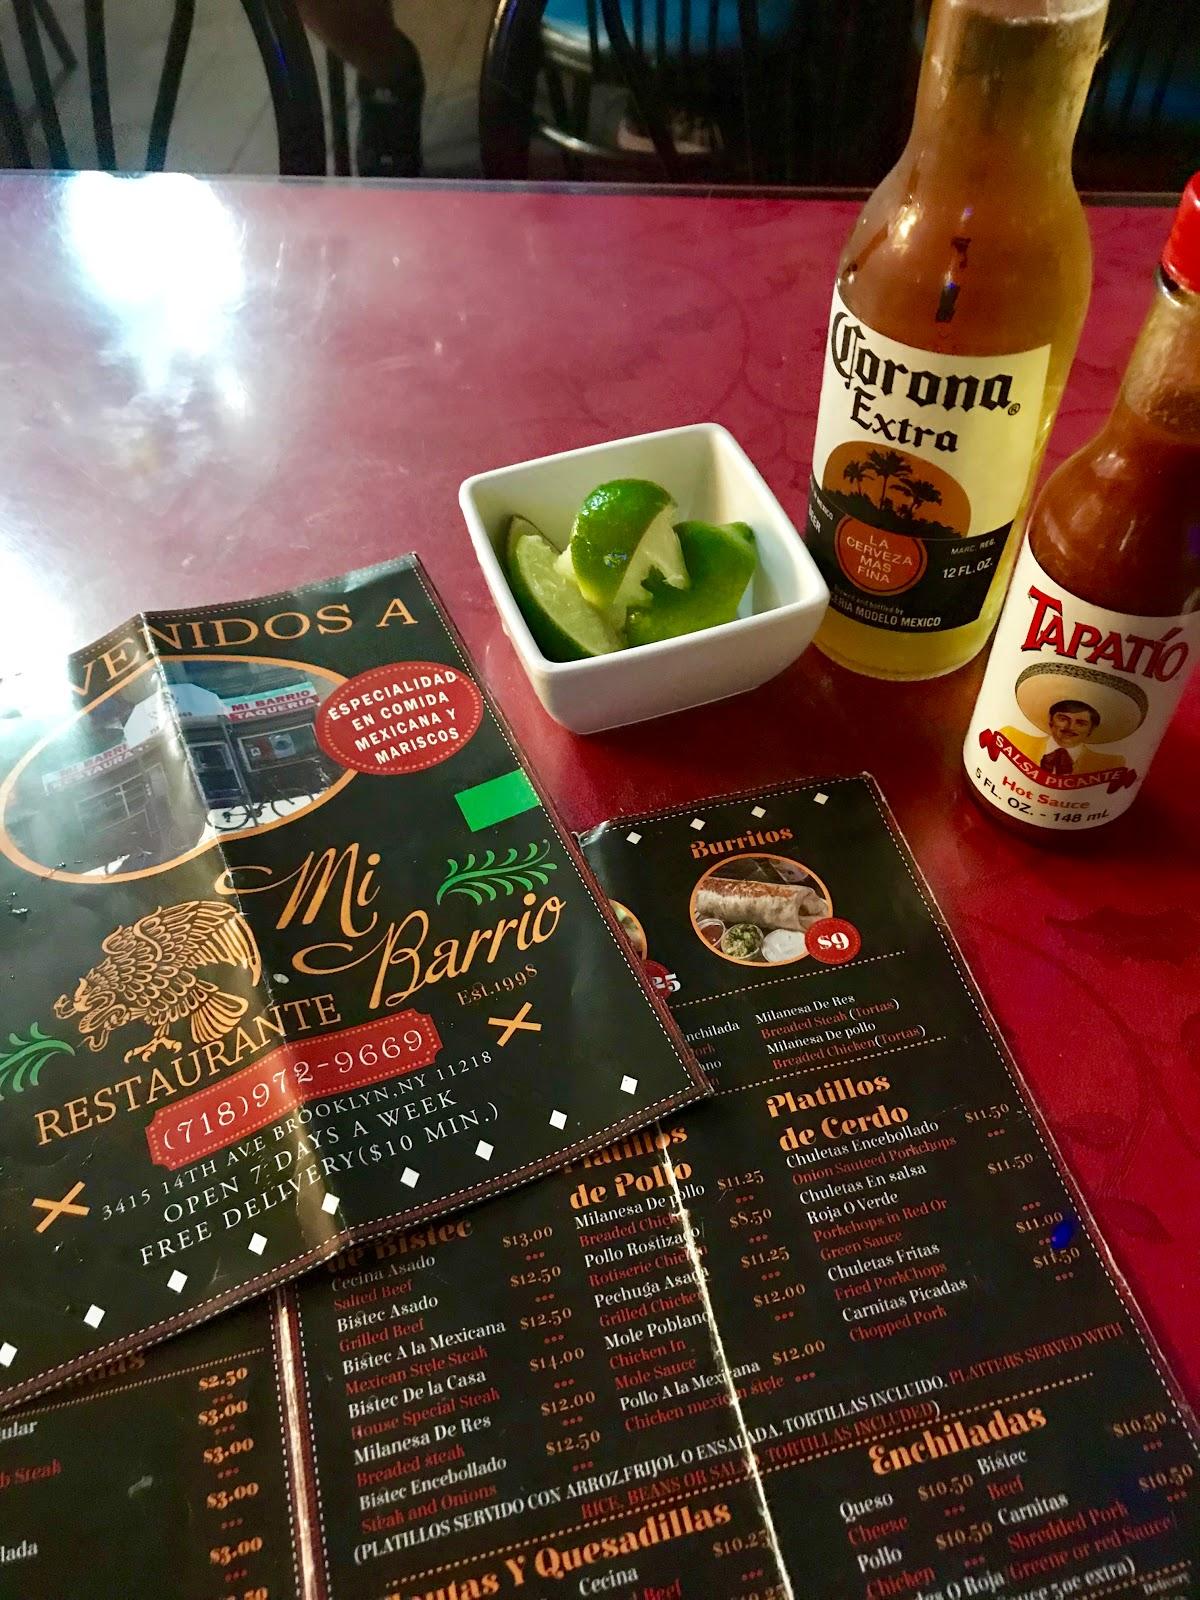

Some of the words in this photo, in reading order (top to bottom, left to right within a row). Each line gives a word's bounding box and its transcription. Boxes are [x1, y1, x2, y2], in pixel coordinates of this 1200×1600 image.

[831, 312, 1014, 411] Corona
[851, 386, 958, 452] Extra
[847, 536, 913, 566] CERVEZA
[870, 535, 889, 548] LA
[858, 567, 890, 584] FINA
[860, 556, 891, 572] MAS
[943, 568, 955, 578] 12
[376, 598, 418, 628] A
[856, 606, 897, 625] MODELO
[900, 617, 941, 627] MEXICO
[232, 702, 250, 712] MI
[255, 690, 310, 707] BARRIO
[328, 670, 457, 721] ESPECIALIDAD
[352, 714, 375, 731] EN
[380, 692, 449, 719] COMIDA
[355, 712, 442, 752] MEXICANA
[446, 708, 456, 720] Y
[375, 728, 459, 765] MARISCOS
[995, 735, 1039, 778] SALSA
[1045, 769, 1122, 788] PICANTE
[975, 767, 982, 779] 5
[983, 778, 1002, 800] FL.
[1007, 797, 1034, 816] OZ.
[1053, 812, 1081, 823] 148
[1087, 809, 1109, 821] mL
[1002, 776, 1032, 800] Hot
[1037, 793, 1090, 810] Sauce
[690, 825, 794, 860] Burritos
[214, 842, 381, 938] Mi
[292, 892, 567, 1010] Barrio
[817, 931, 850, 951] $9
[755, 1005, 812, 1025] Milanesa
[812, 999, 830, 1011] De
[832, 994, 856, 1007] Res
[760, 1018, 813, 1040] Breaded
[814, 1012, 848, 1028] Steak
[766, 1035, 824, 1055] Milanesa
[825, 1028, 844, 1041] De
[845, 1020, 876, 1039] pollo
[35, 994, 342, 1146] RESTAURANTE
[772, 1050, 824, 1071] Breaded
[163, 1029, 424, 1150] (718)972-9669
[766, 1074, 891, 1119] Platillos
[779, 1127, 816, 1152] de
[820, 1105, 909, 1139] Cerdo
[964, 1103, 1010, 1124] $11.50
[102, 1189, 150, 1221] 3415
[162, 1160, 217, 1195] 14TH
[226, 1136, 266, 1166] AVE
[437, 1051, 491, 1081] 11218
[786, 1143, 849, 1170] Chuletas
[852, 1120, 939, 1153] Encebollado
[164, 1176, 240, 1224] OPEN
[274, 1126, 339, 1172] DAYS
[353, 1120, 368, 1137] A
[376, 1090, 457, 1127] WEEK
[792, 1165, 834, 1186] Onion
[888, 1135, 957, 1162] Porkchops
[987, 1153, 1034, 1175] $11.50
[140, 1222, 212, 1266] FREE
[424, 1102, 498, 1143] MIN.)
[717, 1169, 764, 1191] $11.25
[799, 1179, 864, 1205] Chuletas
[866, 1174, 886, 1188] En
[888, 1163, 927, 1182] salsa
[569, 1183, 607, 1210] de
[574, 1202, 644, 1230] Milanesa
[646, 1194, 667, 1212] De
[805, 1205, 842, 1225] Roja
[844, 1200, 856, 1215] O
[856, 1191, 899, 1212] Verde
[729, 1208, 772, 1229] $8.50
[813, 1213, 884, 1244] Porkchops
[902, 1203, 930, 1221] Red
[1016, 1211, 1063, 1233] $11.00
[502, 1226, 553, 1249] $13.00
[819, 1241, 861, 1261] Green
[863, 1230, 904, 1249] Sauce
[332, 1268, 384, 1292] Cecina
[387, 1255, 436, 1278] Asado
[584, 1249, 624, 1268] Pollo
[740, 1246, 790, 1269] $11.25
[827, 1255, 894, 1282] Chuletas
[896, 1243, 940, 1264] Fritas
[510, 1266, 561, 1288] $12.50
[594, 1277, 661, 1309] Pechuga
[834, 1279, 870, 1301] Fried
[753, 1283, 806, 1309] $12.00
[841, 1295, 907, 1323] Carnitas
[909, 1277, 968, 1303] Picadas
[337, 1307, 386, 1333] Bistec
[389, 1294, 439, 1319] Asado
[519, 1307, 573, 1330] $12.50
[849, 1315, 912, 1343] Chopped
[913, 1305, 948, 1326] Pork
[342, 1351, 392, 1375] Bistec
[397, 1341, 408, 1360] A
[411, 1337, 426, 1355] la
[429, 1320, 506, 1351] Mexicana
[604, 1322, 644, 1350] Mole
[530, 1347, 584, 1372] $14.00
[609, 1344, 672, 1371] Chicken
[772, 1340, 825, 1366] $12.00
[199, 1367, 248, 1390] $2.50
[613, 1369, 651, 1390] Mole
[653, 1356, 697, 1380] Sauce
[349, 1395, 399, 1419] Bistec
[402, 1386, 424, 1405] De
[428, 1380, 443, 1399] la
[446, 1369, 486, 1391] Casa
[541, 1390, 596, 1416] $12.00
[199, 1400, 248, 1426] $3.00
[203, 1438, 254, 1464] $3.00
[353, 1433, 430, 1466] Milanesa
[434, 1423, 456, 1442] De
[461, 1414, 492, 1434] Res
[546, 1430, 600, 1456] $12.50
[868, 1406, 1047, 1476] Enchiladas
[354, 1512, 451, 1562] (PLATILLOS
[454, 1495, 524, 1525] SERVIDO
[528, 1484, 561, 1511] CON
[783, 1396, 869, 1433] TORTILLAS
[870, 1374, 948, 1407] INCLUIDO.
[976, 1448, 1028, 1476] Bistec
[207, 1482, 259, 1510] $3.00
[359, 1486, 407, 1512] Bistec
[411, 1455, 507, 1495] Encebollado
[839, 1492, 893, 1523] Queso
[998, 1491, 1069, 1526] Carnitas
[210, 1536, 262, 1566] $3.00
[506, 1555, 526, 1587] Y
[535, 1503, 731, 1580] Quesadillas
[857, 1546, 902, 1573] Pollo
